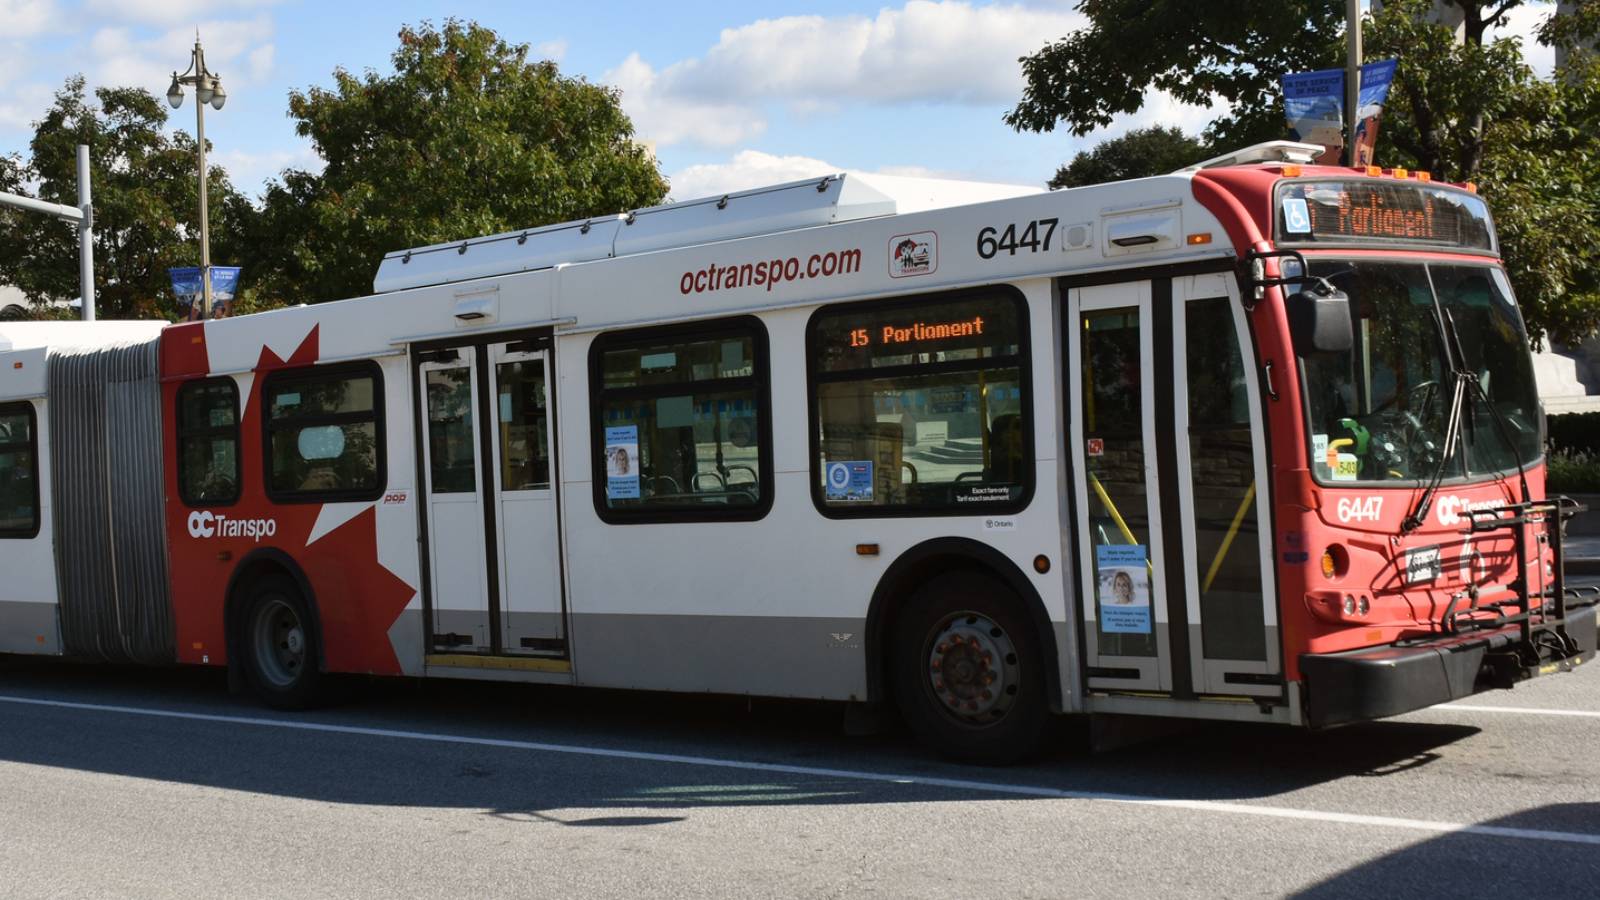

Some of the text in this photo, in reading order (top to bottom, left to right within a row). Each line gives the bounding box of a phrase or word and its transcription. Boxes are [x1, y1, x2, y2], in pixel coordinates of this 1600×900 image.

[1295, 79, 1308, 87] THE
[1310, 76, 1340, 86] SERVICE
[1307, 85, 1329, 94] PEACE
[1338, 190, 1434, 238] Parliament
[976, 217, 1059, 260] 6447
[680, 248, 862, 295] octranspo.com
[850, 316, 984, 347] 15 Parliament
[1337, 496, 1383, 523] 6447
[1436, 495, 1461, 526] OC
[187, 510, 276, 542] OC Transpo
